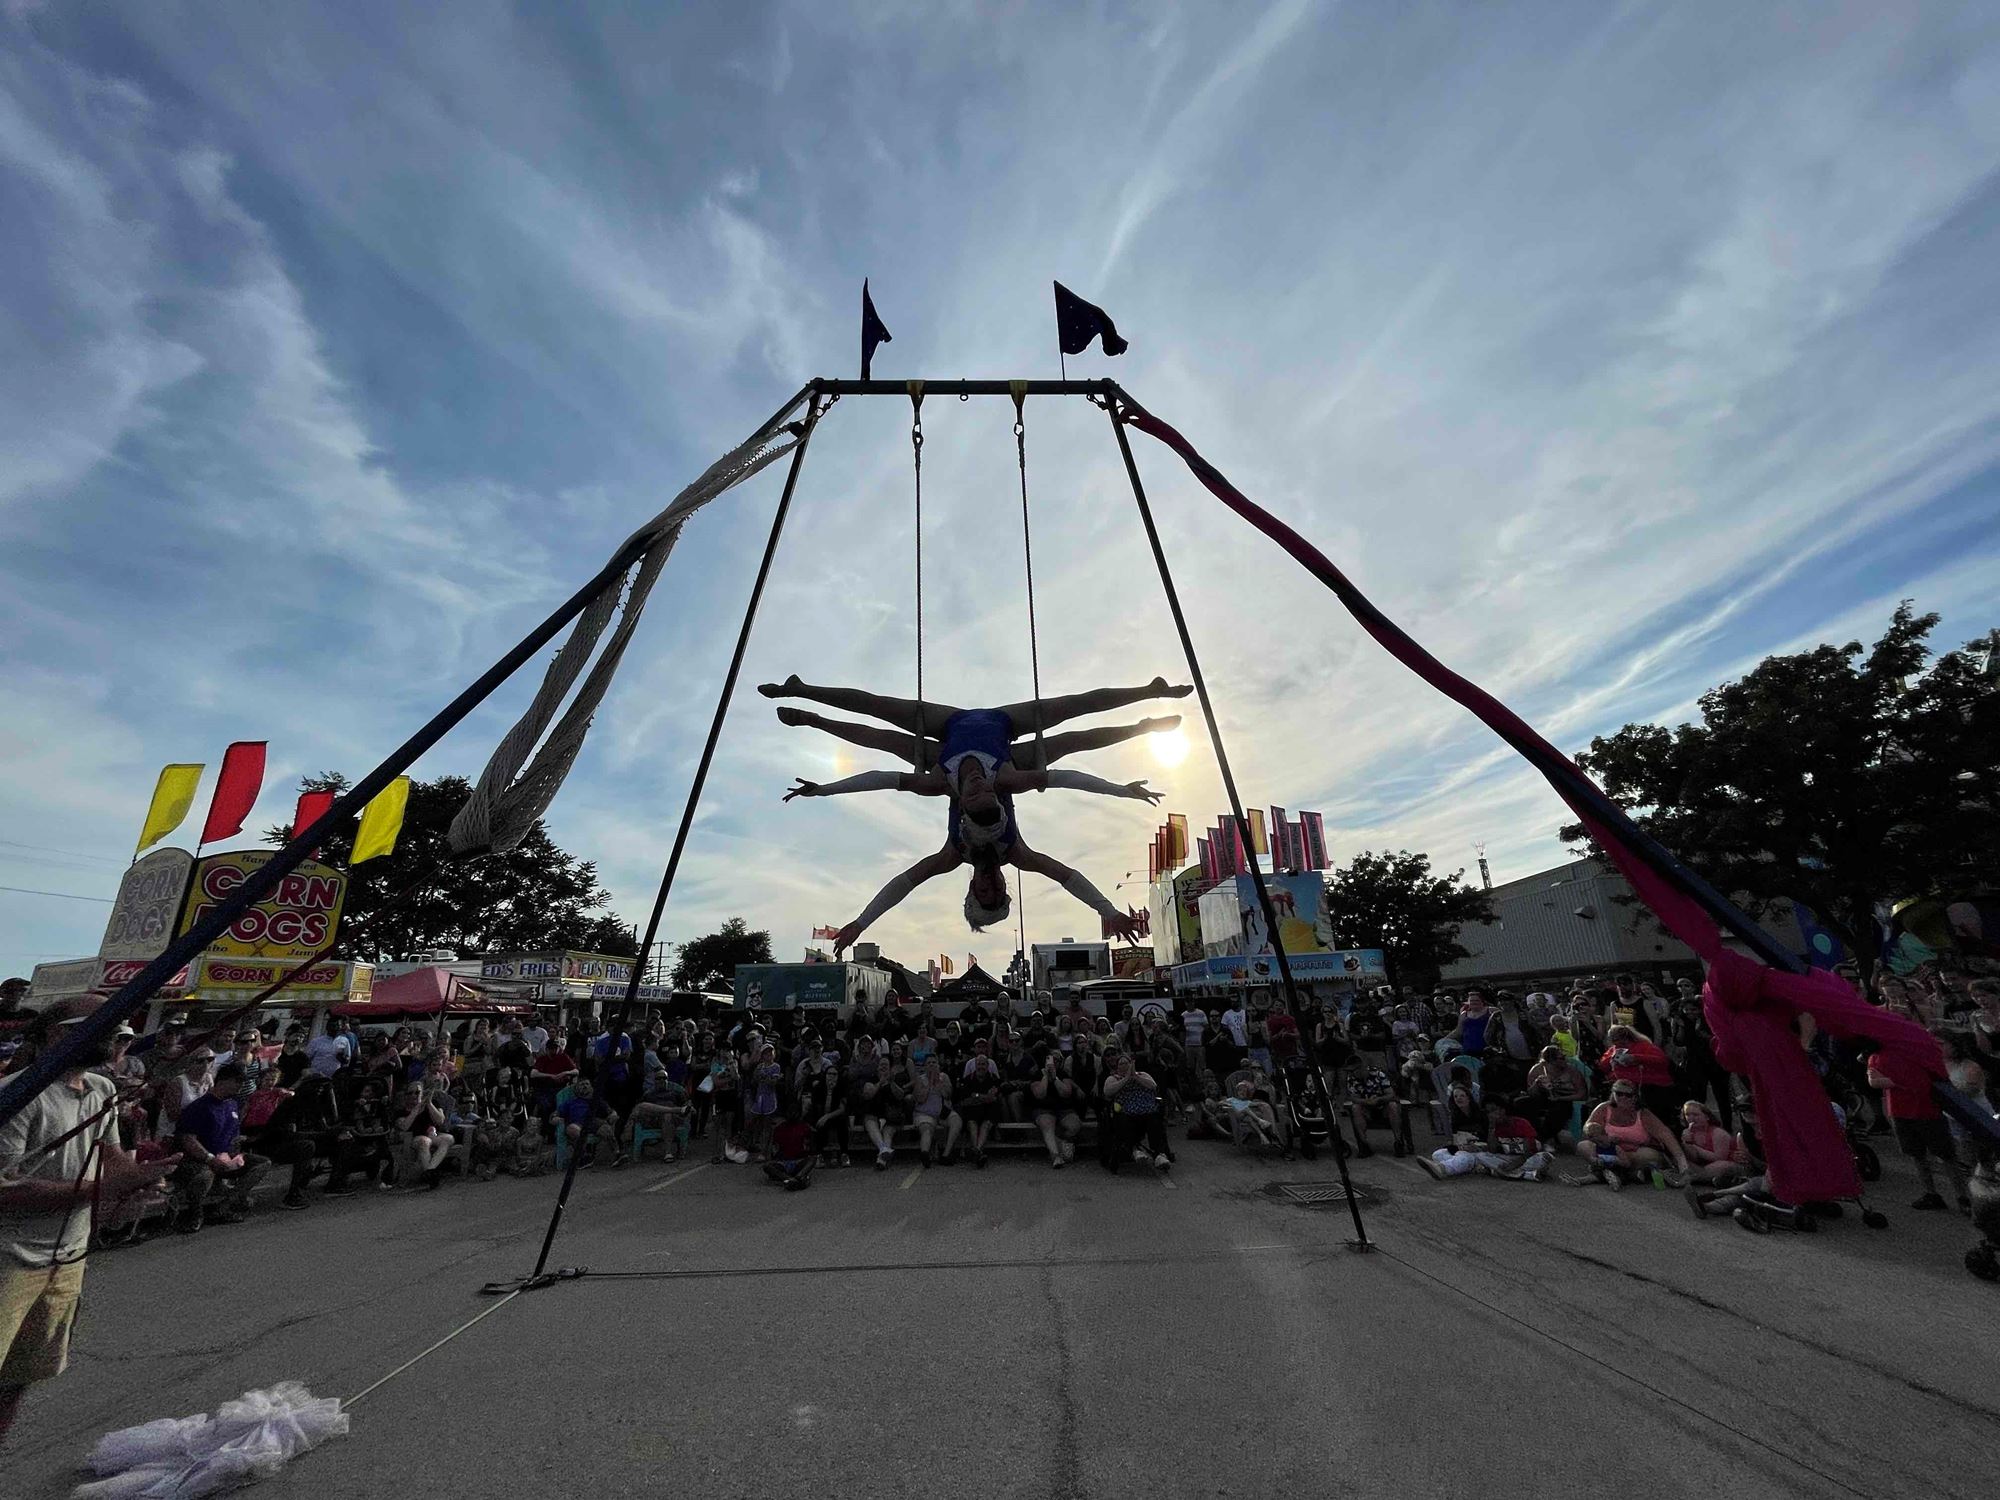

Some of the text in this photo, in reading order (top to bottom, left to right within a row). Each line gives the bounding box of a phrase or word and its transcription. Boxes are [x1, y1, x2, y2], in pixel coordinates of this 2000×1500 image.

[209, 966, 273, 982] CORN
[520, 962, 560, 976] FRIES
[605, 962, 629, 979] FRIES
